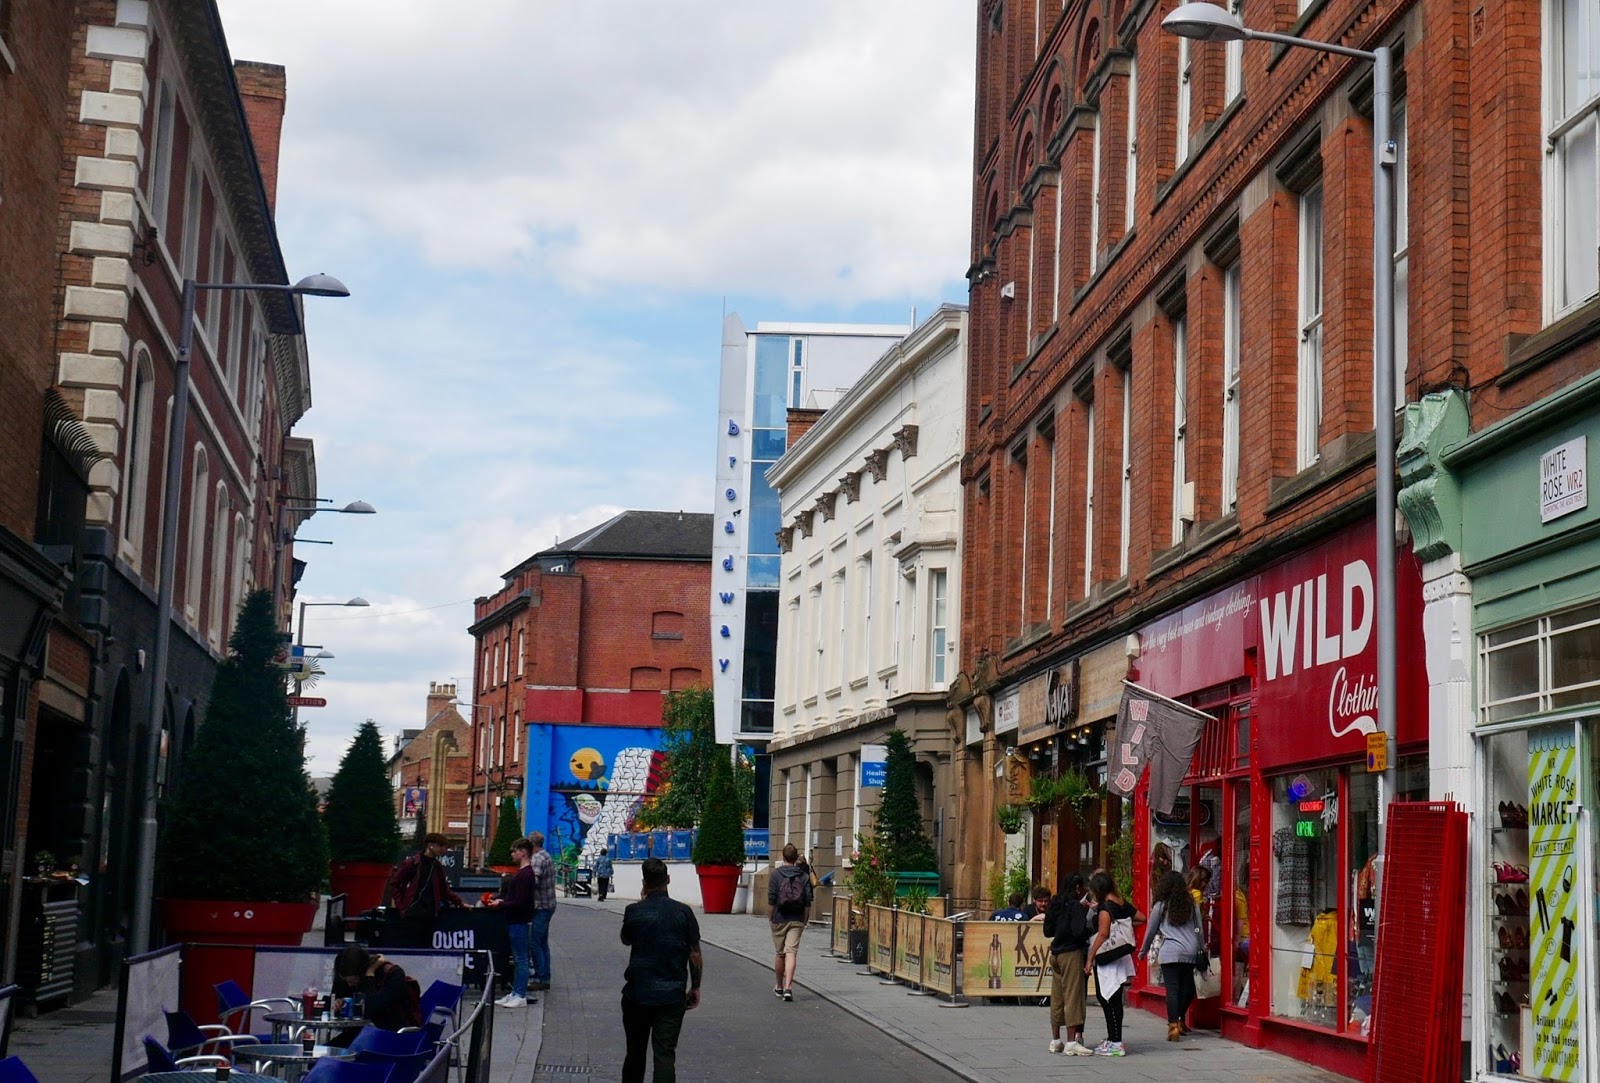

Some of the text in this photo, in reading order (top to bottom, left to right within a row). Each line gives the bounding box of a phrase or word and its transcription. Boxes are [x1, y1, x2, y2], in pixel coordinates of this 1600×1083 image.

[1543, 449, 1567, 478] WHITE
[1543, 469, 1583, 502] ROSE WR2
[719, 419, 739, 673] broadway
[1260, 558, 1374, 681] WILD
[1329, 666, 1379, 738] Clothin
[1115, 700, 1149, 792] WILD
[1530, 774, 1576, 799] WHITE ROSE
[1532, 800, 1574, 827] MARKET
[1014, 922, 1051, 992] Kay
[1536, 1014, 1556, 1028] Brilliant
[1536, 1031, 1542, 1042] to
[1543, 1032, 1549, 1043] be
[1551, 1033, 1561, 1045] had
